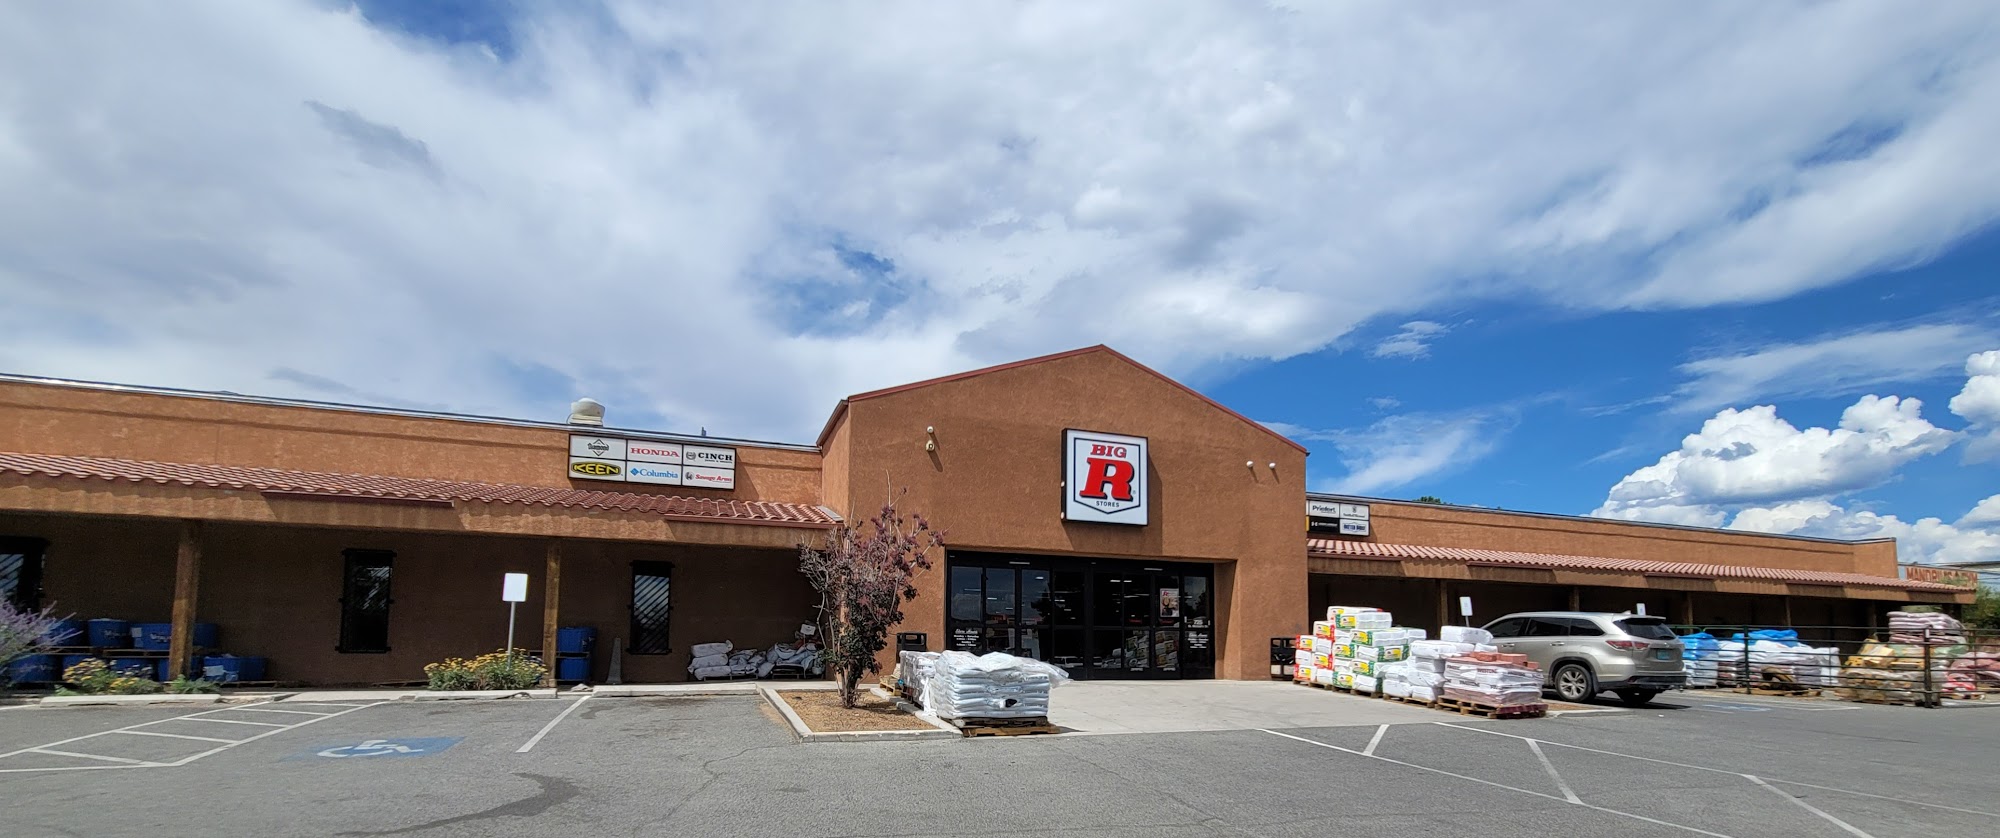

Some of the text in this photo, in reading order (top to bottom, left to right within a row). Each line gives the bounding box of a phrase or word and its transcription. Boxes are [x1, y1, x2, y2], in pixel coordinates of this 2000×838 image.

[630, 447, 680, 458] HONDA
[698, 452, 733, 461] CINCH
[1090, 444, 1127, 458] BIG
[573, 463, 620, 475] KEEN
[639, 468, 679, 479] Columbia
[1079, 457, 1135, 502] R
